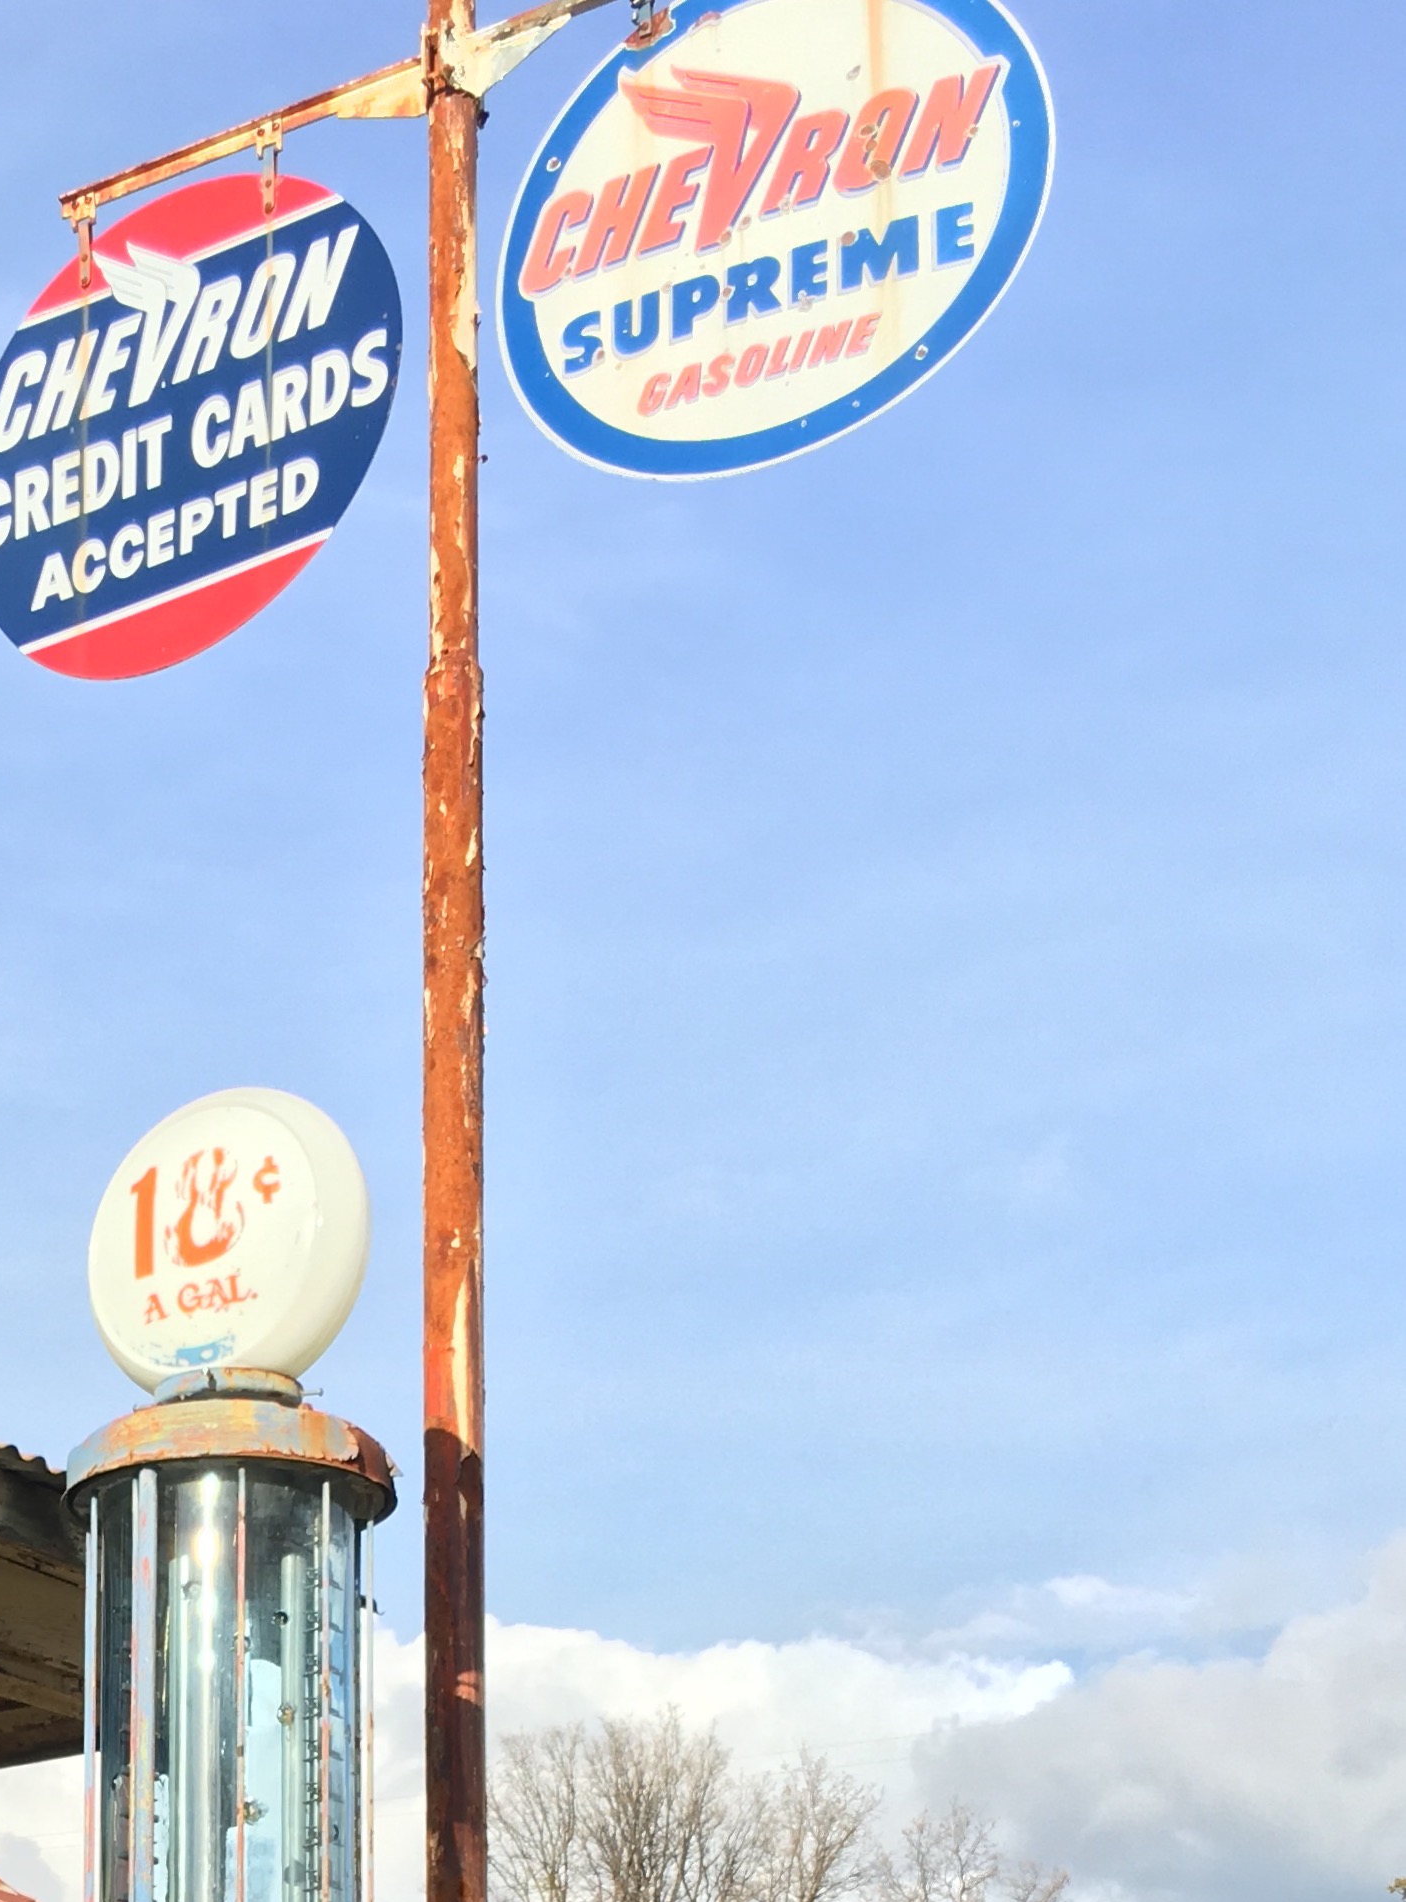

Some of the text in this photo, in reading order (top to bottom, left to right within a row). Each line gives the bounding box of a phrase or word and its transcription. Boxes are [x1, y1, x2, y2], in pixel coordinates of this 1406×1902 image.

[519, 62, 1003, 298] CHEVRON
[561, 202, 974, 379] SUPREME
[637, 312, 883, 416] GASOLINE
[191, 328, 389, 469] CARDS
[30, 456, 320, 612] ACCEPTED
[144, 1271, 258, 1326] A GAL.
